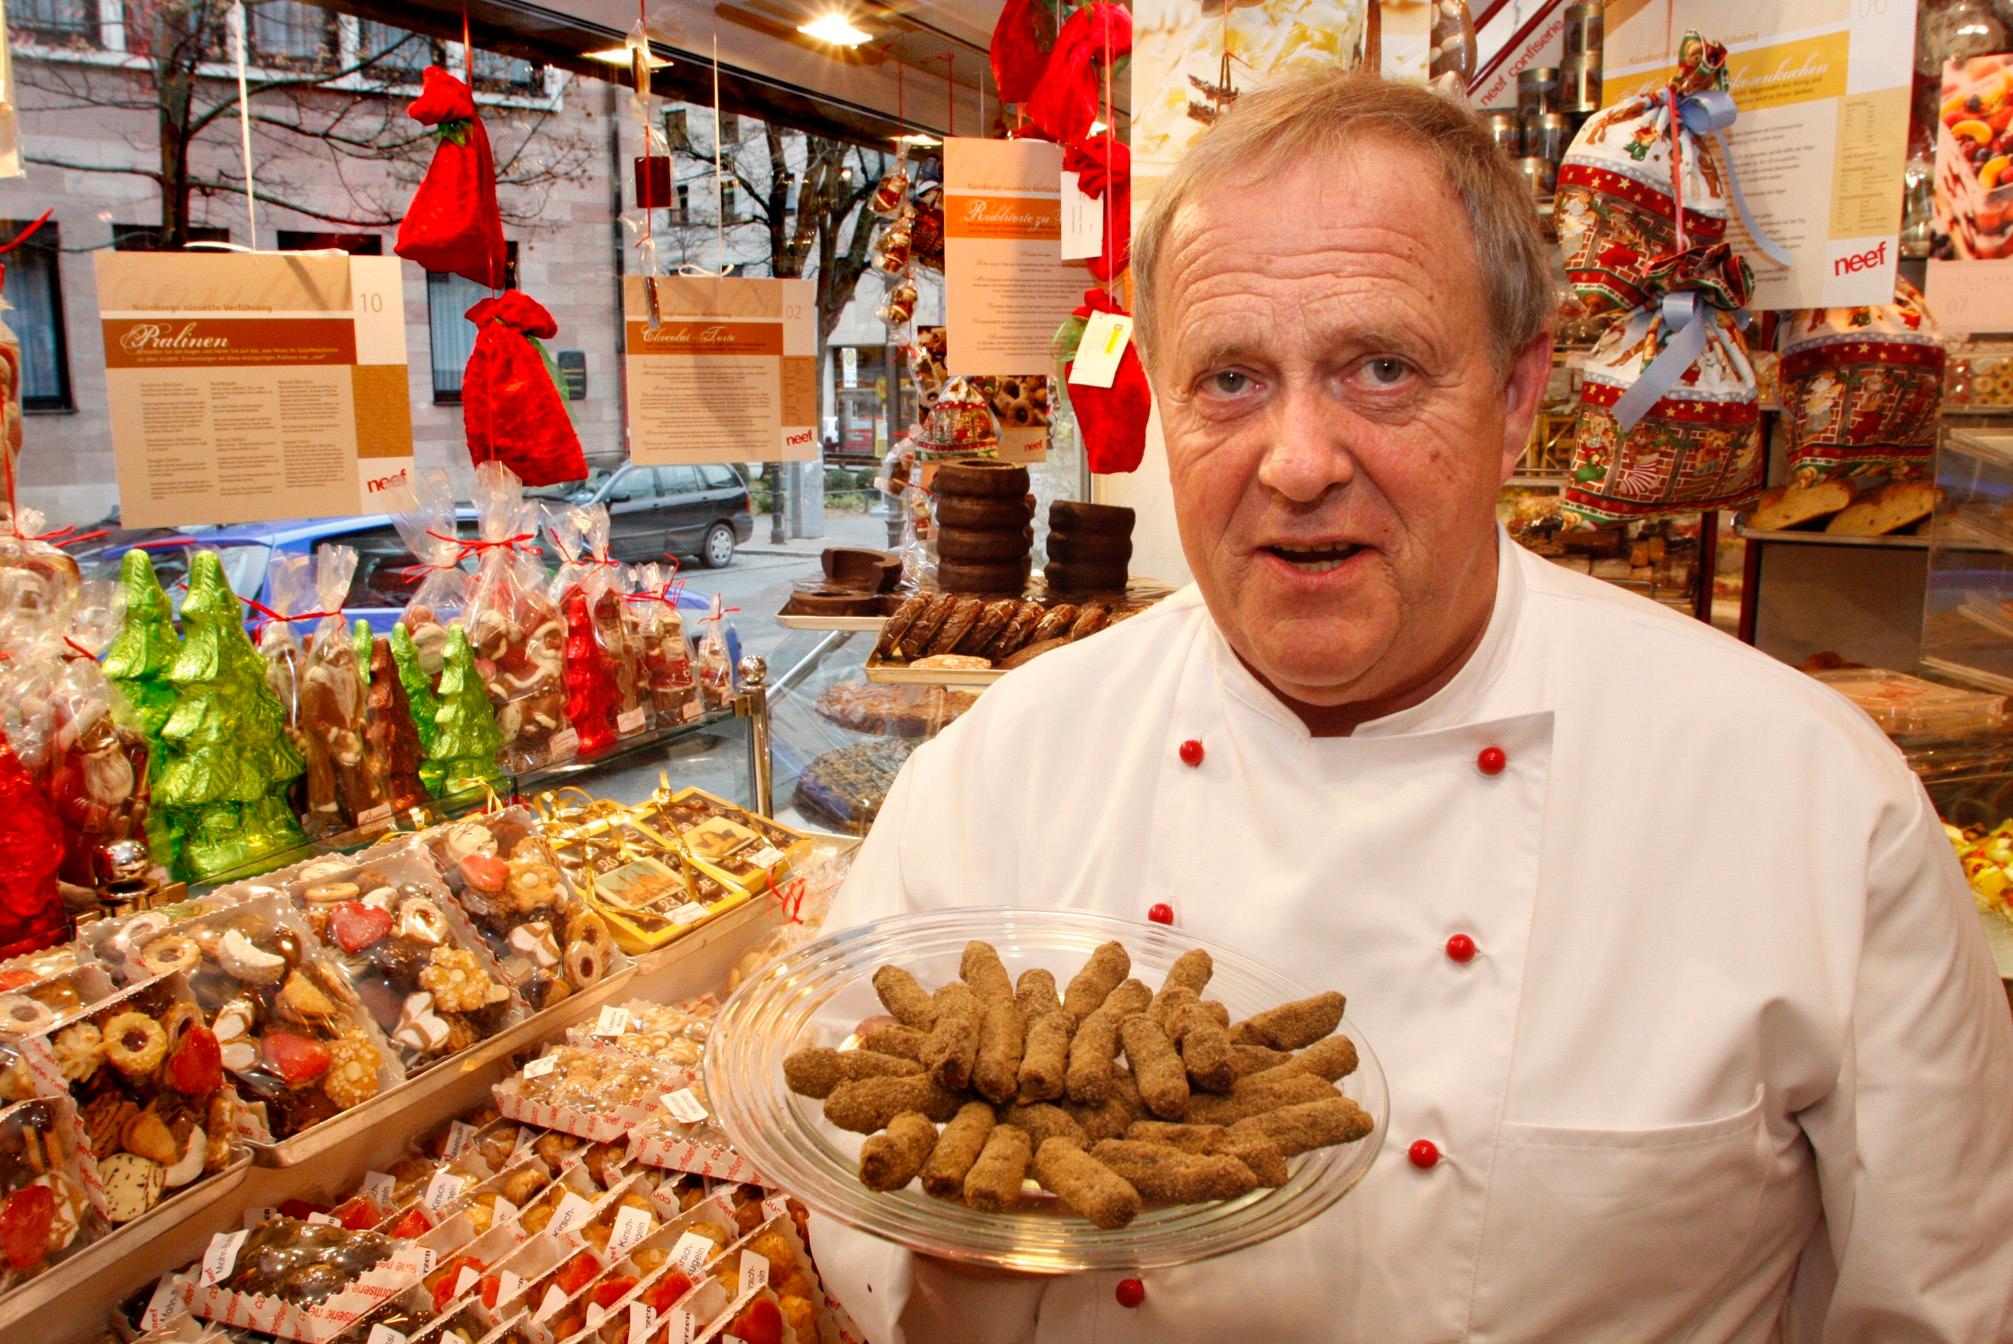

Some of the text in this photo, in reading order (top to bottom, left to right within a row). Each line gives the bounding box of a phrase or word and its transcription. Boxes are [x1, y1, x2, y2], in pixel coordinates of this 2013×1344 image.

[1480, 19, 1565, 106] neef confiserie
[1834, 241, 1886, 277] neef
[359, 292, 383, 314] 10
[120, 321, 229, 354] Pralinen
[786, 429, 813, 446] neef
[366, 468, 407, 493] neef
[619, 1218, 634, 1247] Kirsch-
